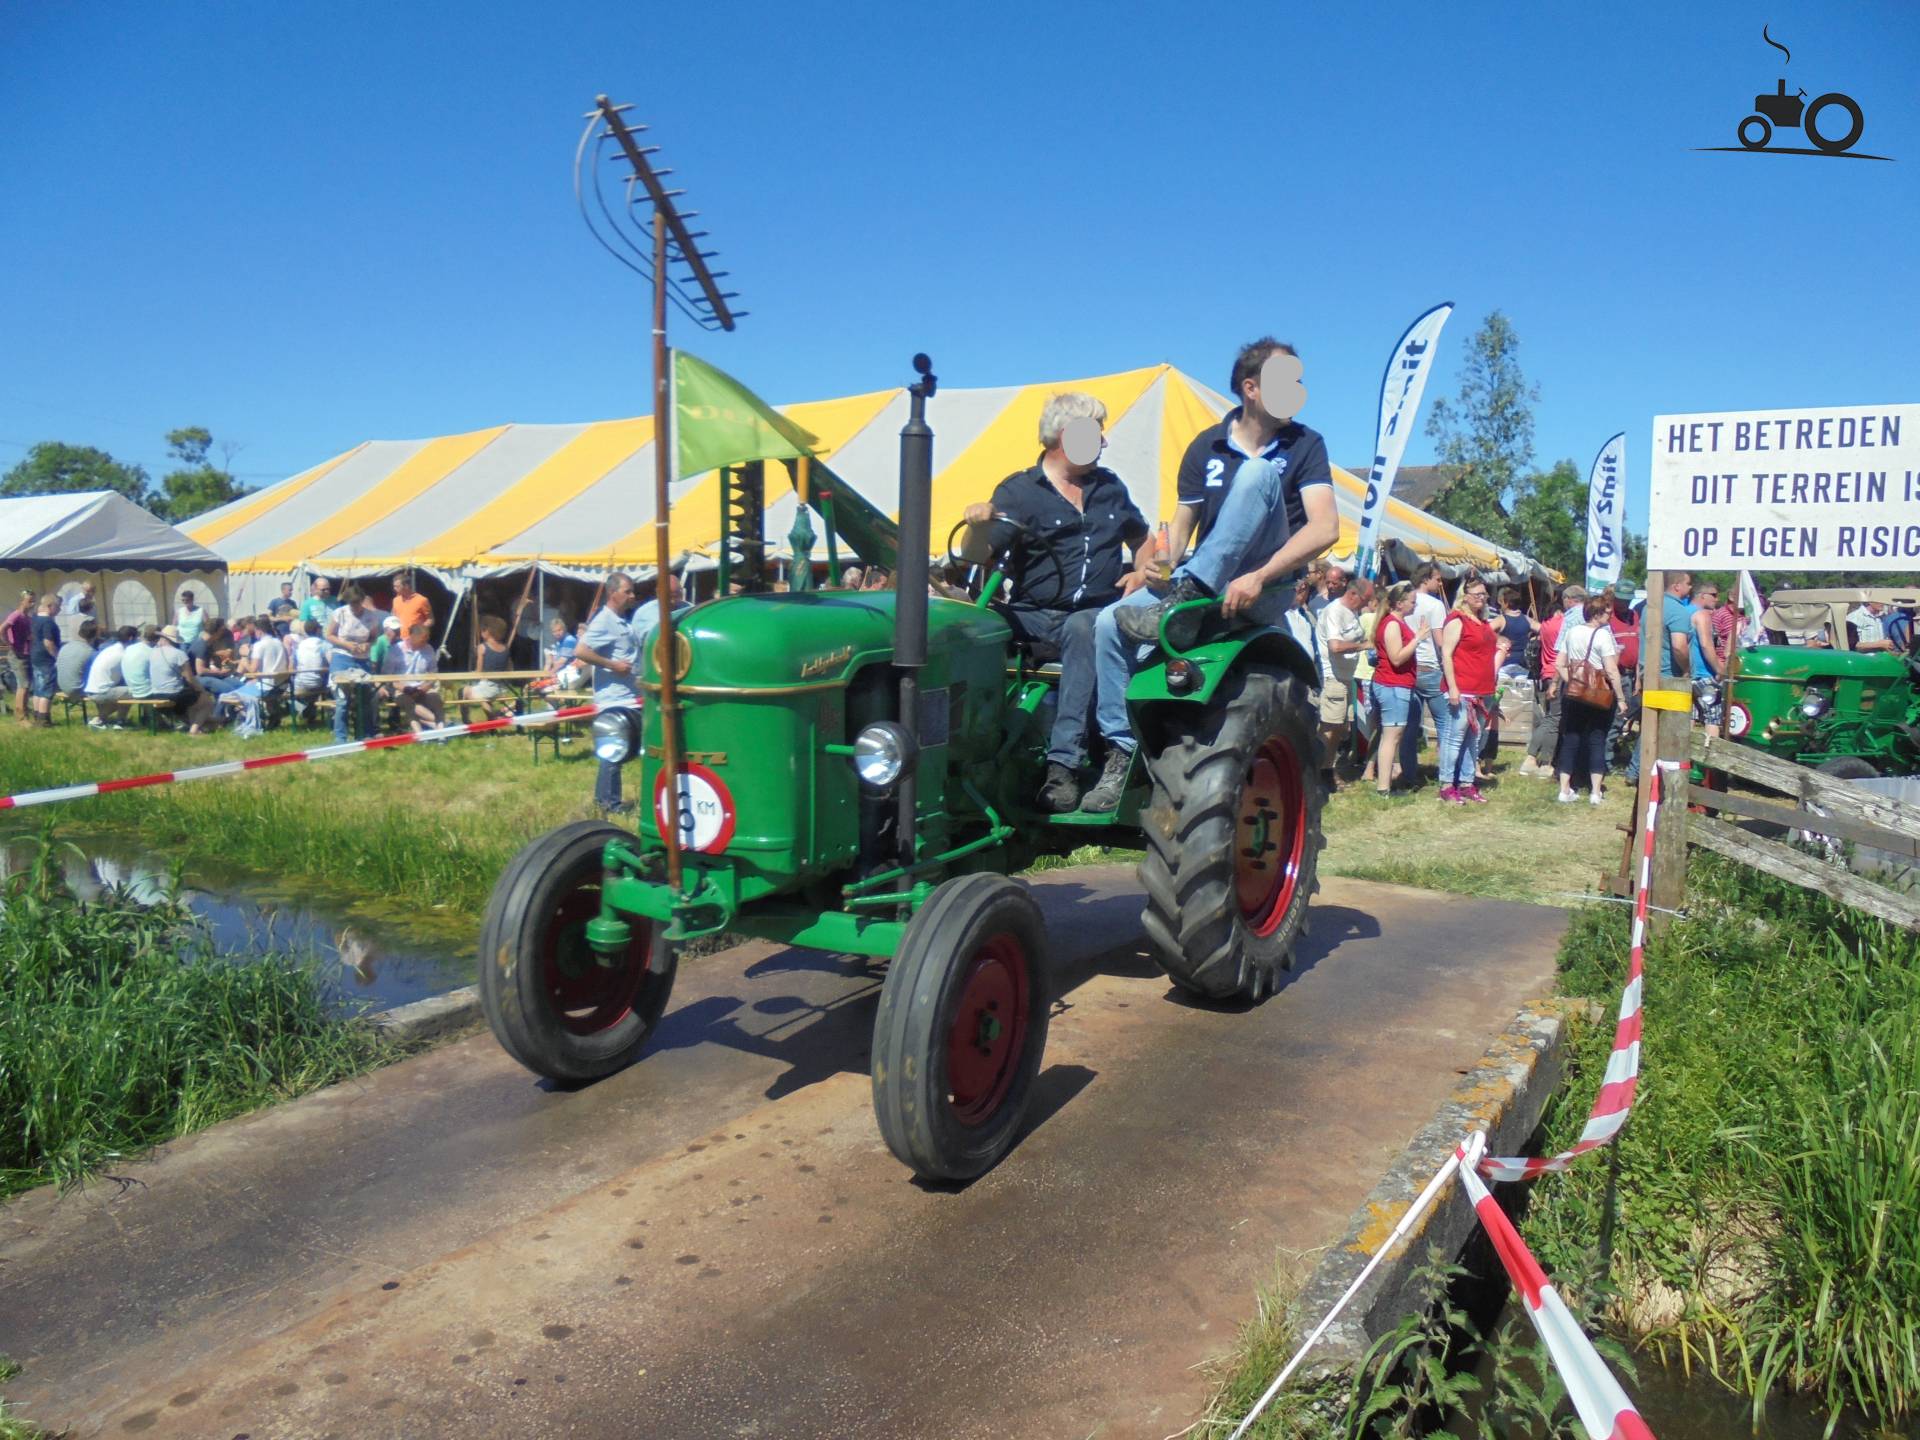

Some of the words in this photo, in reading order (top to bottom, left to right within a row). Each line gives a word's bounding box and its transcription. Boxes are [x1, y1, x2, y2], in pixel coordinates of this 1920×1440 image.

[1667, 422, 1724, 453] HET
[1734, 415, 1901, 452] BETREDEN
[1206, 458, 1225, 487] 2
[1596, 454, 1617, 515] Smit
[1691, 473, 1739, 504] DIT
[1752, 471, 1887, 504] TERREIN
[1588, 526, 1614, 571] Ton
[1683, 527, 1719, 558] OP
[1730, 527, 1819, 558] EIGEN
[696, 799, 716, 816] KM
